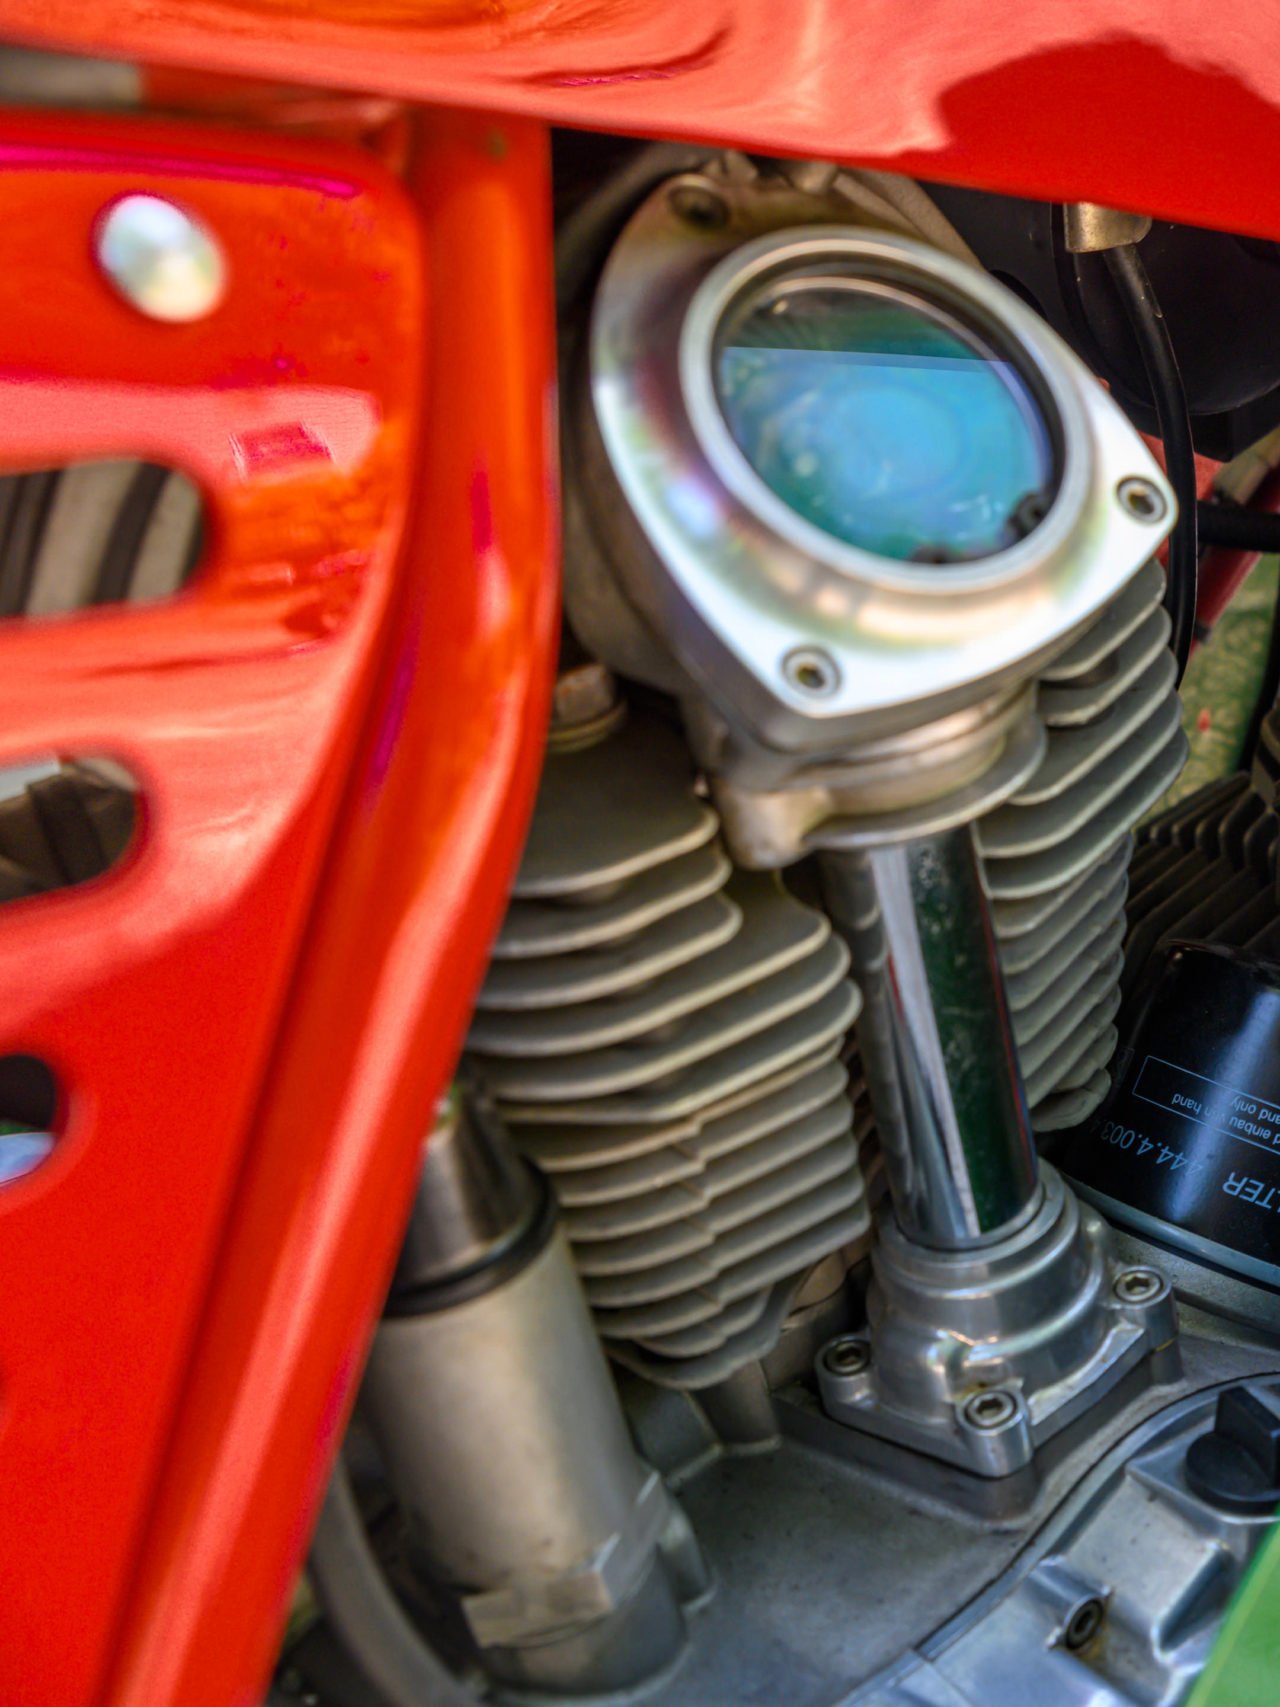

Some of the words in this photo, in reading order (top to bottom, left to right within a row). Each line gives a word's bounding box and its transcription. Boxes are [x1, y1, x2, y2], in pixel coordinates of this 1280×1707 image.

[1171, 1093, 1202, 1115] hand
[1231, 1096, 1257, 1114] only
[1229, 1116, 1271, 1140] einbau
